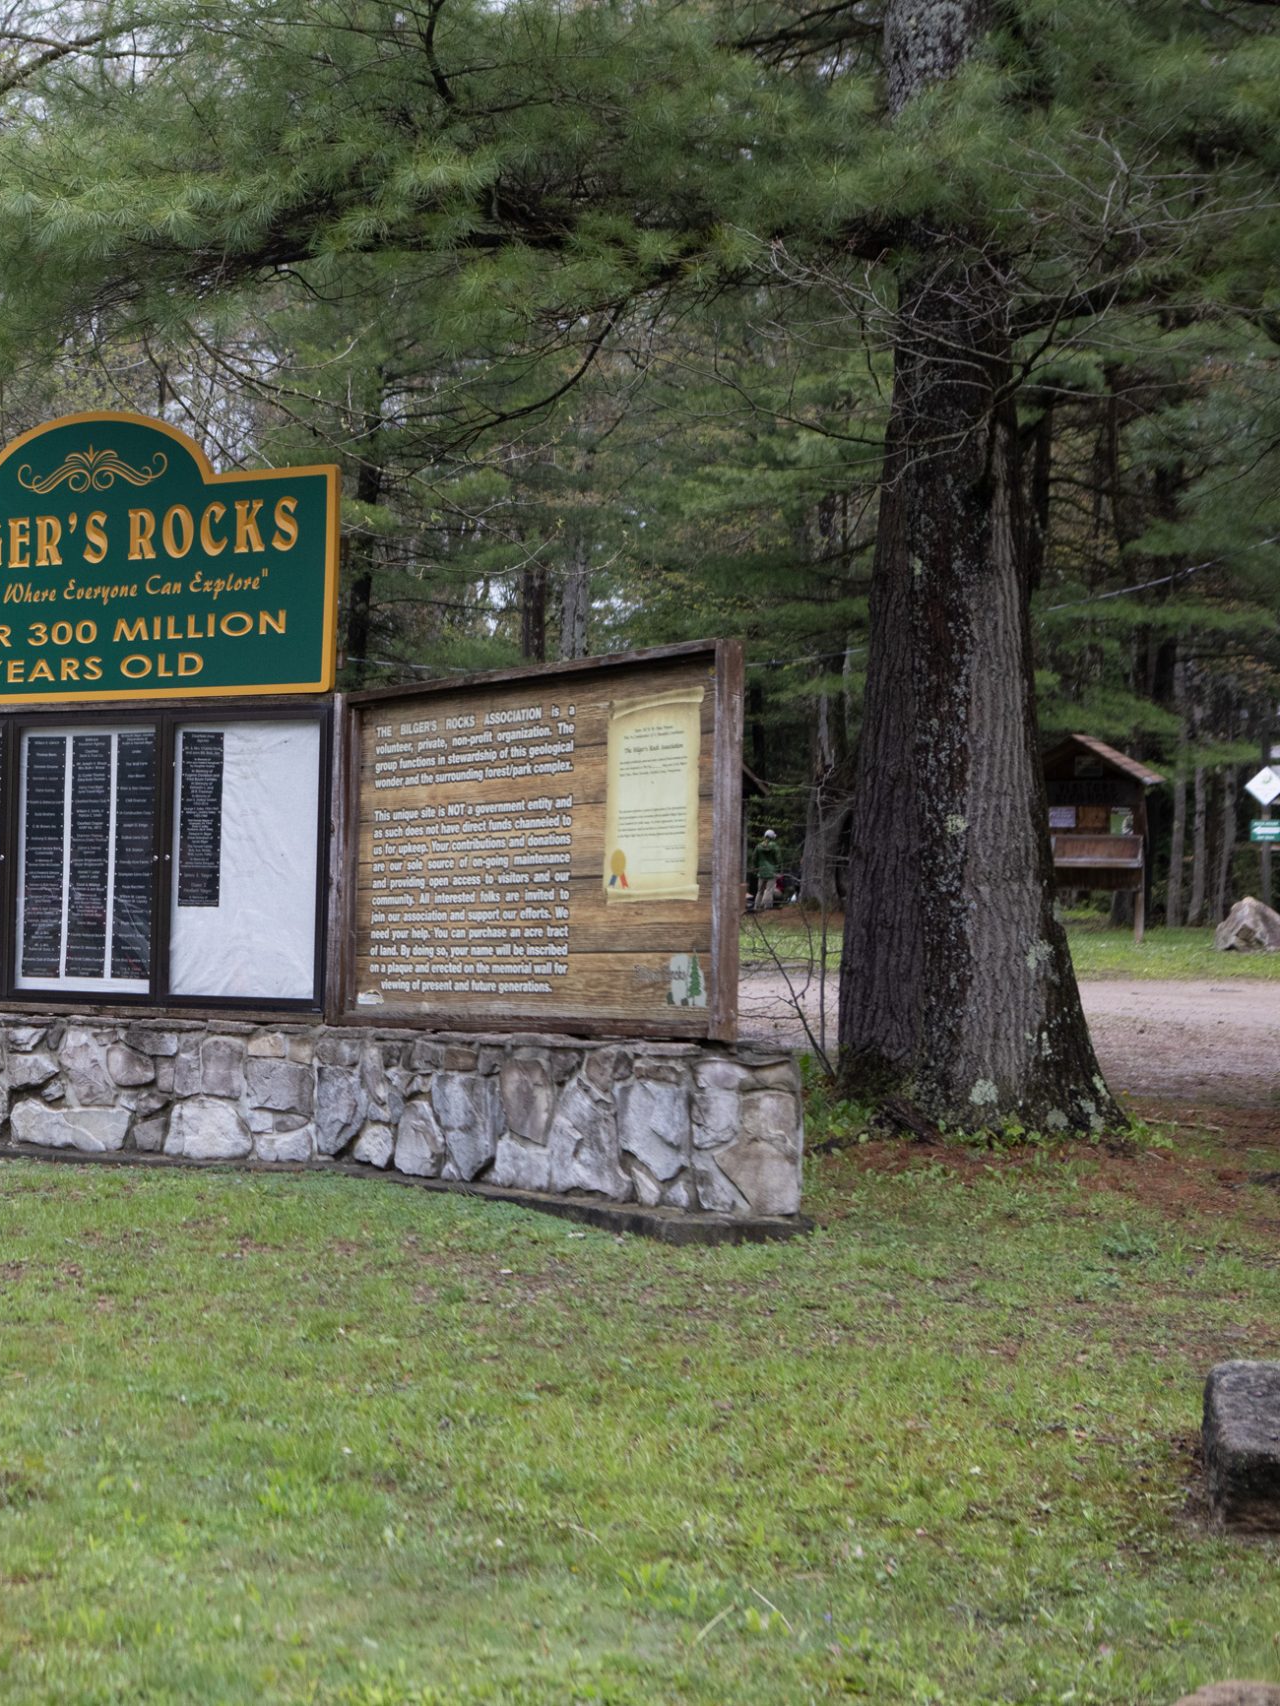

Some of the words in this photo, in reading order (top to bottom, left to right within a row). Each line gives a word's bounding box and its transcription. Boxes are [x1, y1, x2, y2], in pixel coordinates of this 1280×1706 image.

[127, 496, 300, 561] ROCKS
[3, 582, 57, 605] Where
[63, 578, 138, 605] Everyone
[145, 574, 182, 596] Can
[189, 568, 269, 600] Explore"
[27, 619, 99, 647] 300
[112, 609, 287, 643] MILLION
[120, 652, 204, 679] OLD
[377, 725, 392, 738] THE
[400, 720, 437, 735] BILGER'S
[446, 716, 475, 730] ROCKS
[484, 707, 542, 726] ASSOCIATION
[552, 706, 559, 717] is
[569, 706, 575, 715] a
[376, 743, 413, 755] volunteer,
[417, 738, 448, 752] private,
[452, 730, 493, 747] non-profit
[497, 726, 552, 743] organization.
[557, 722, 575, 734] The
[375, 761, 398, 773] group
[400, 755, 435, 769] functions
[438, 754, 446, 765] in
[448, 748, 497, 764] stewardship
[499, 746, 508, 758] of
[511, 745, 527, 758] this
[529, 740, 574, 758] geological
[375, 775, 403, 789] wonder
[405, 775, 419, 786] and
[421, 773, 433, 784] the
[435, 768, 483, 782] surrounding
[485, 762, 531, 778] forest/park
[533, 760, 573, 774] complex.
[374, 810, 391, 821] This
[392, 808, 419, 821] unique
[421, 806, 436, 819] site
[438, 806, 445, 817] is
[448, 804, 465, 816] NOT
[468, 805, 473, 814] a
[475, 800, 525, 816] government
[528, 798, 553, 811] entity
[555, 796, 572, 808] and
[373, 829, 383, 839] as
[385, 825, 403, 837] such
[405, 824, 424, 837] does
[426, 824, 439, 835] not
[441, 822, 460, 834] have
[462, 820, 486, 833] direct
[489, 818, 512, 831] funds
[515, 815, 560, 829] channeled
[562, 815, 571, 826] to
[373, 846, 383, 855] us
[385, 842, 396, 854] for
[398, 842, 429, 856] upkeep.
[431, 841, 449, 852] Your
[452, 837, 506, 851] contributions
[509, 836, 525, 848] and
[528, 833, 571, 846] donations
[373, 862, 385, 872] are
[390, 860, 402, 871] our
[407, 858, 422, 870] sole
[428, 859, 454, 869] source
[460, 856, 469, 867] of
[472, 855, 509, 869] on-going
[513, 853, 570, 865] maintenance
